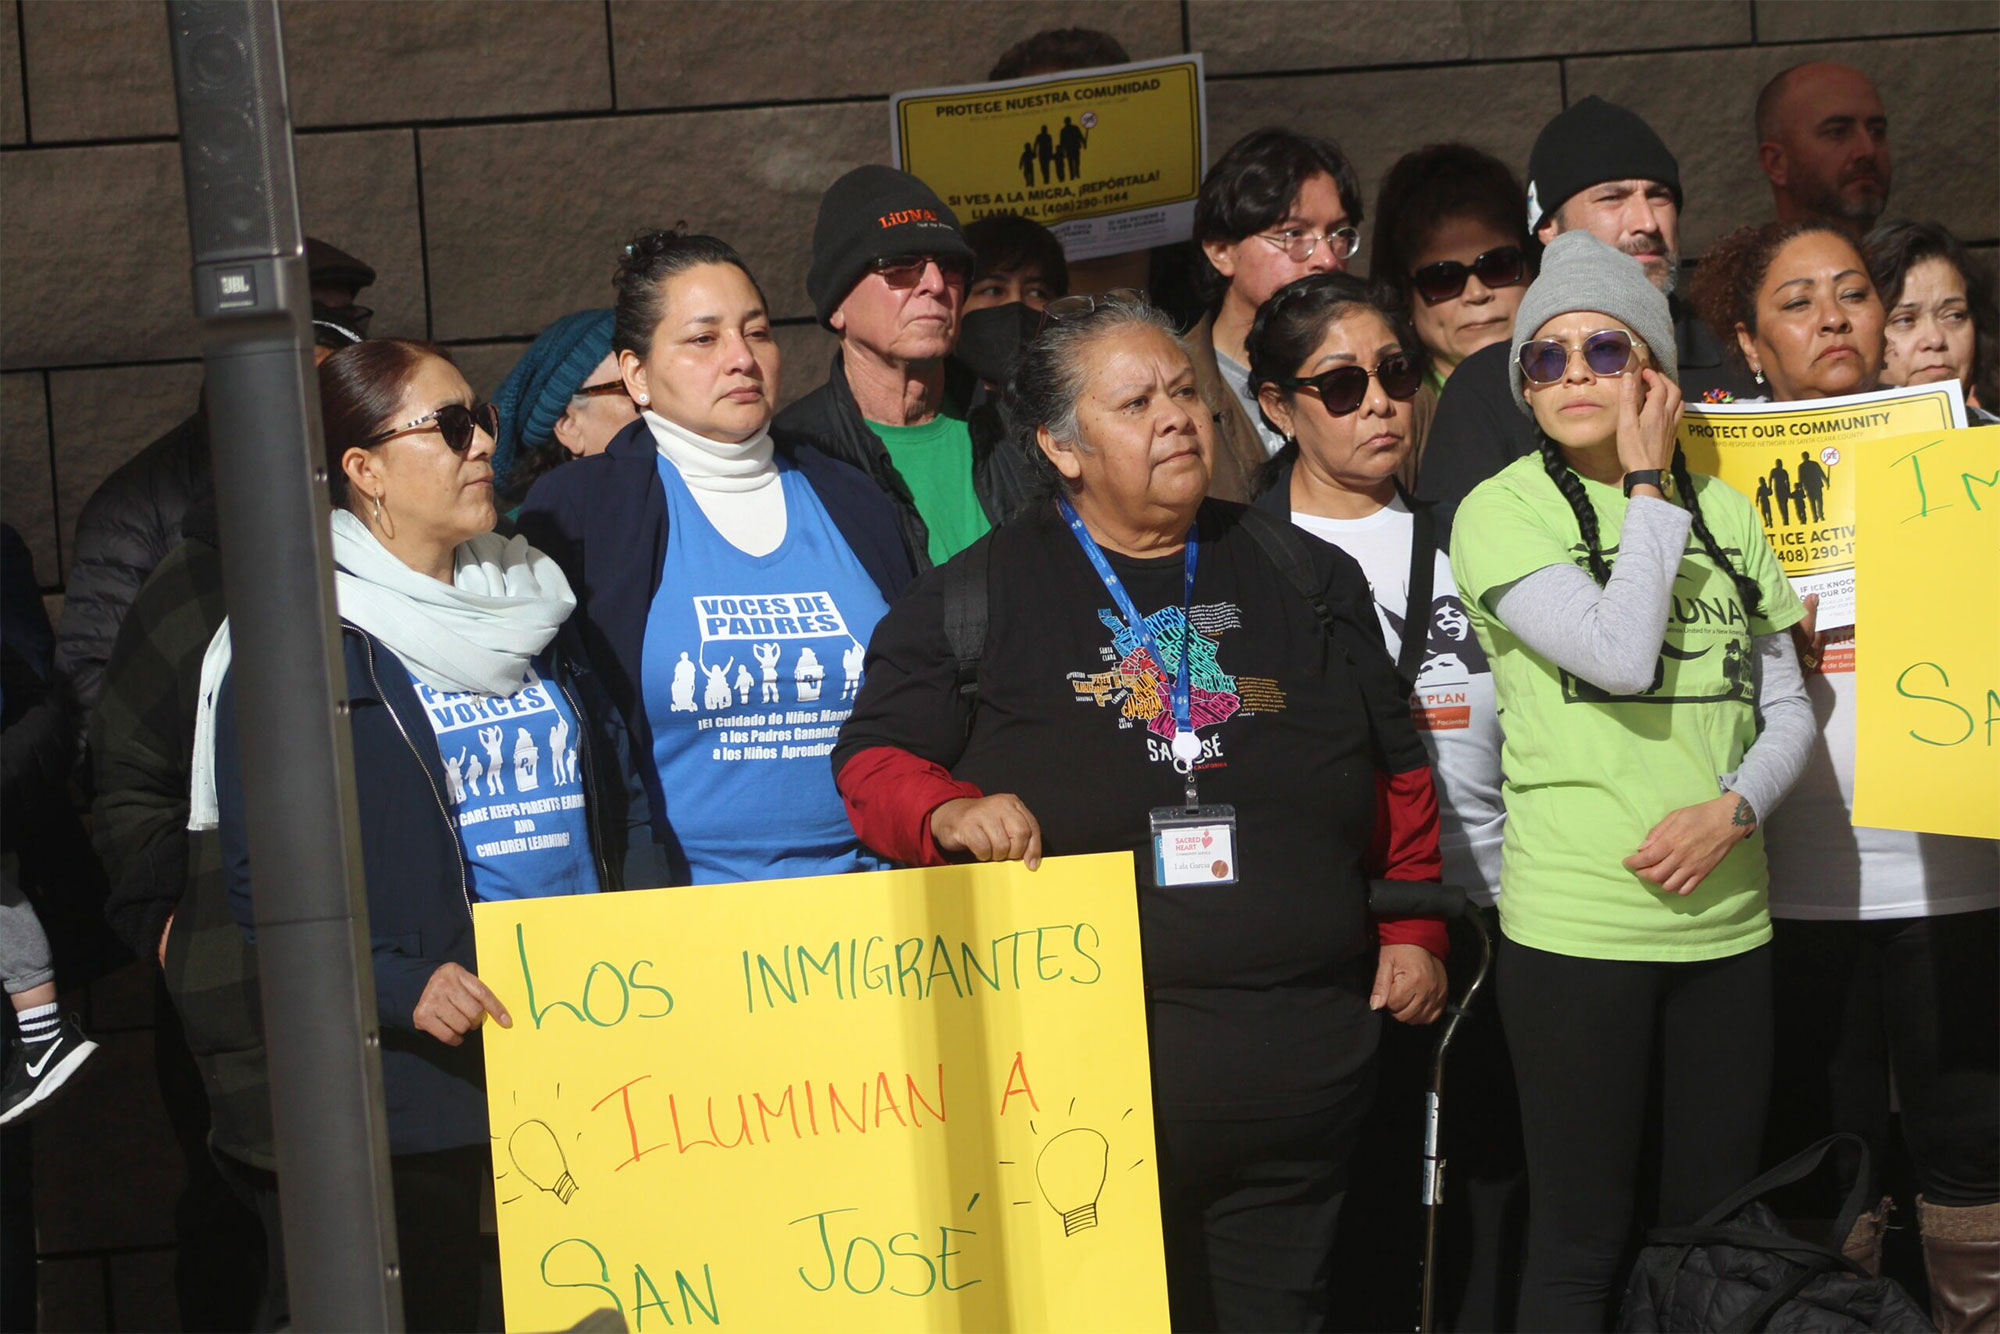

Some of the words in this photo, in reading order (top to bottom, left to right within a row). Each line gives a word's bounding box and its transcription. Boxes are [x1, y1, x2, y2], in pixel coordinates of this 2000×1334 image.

[936, 101, 1002, 117] PROTEGE
[1006, 91, 1070, 110] NUESTRA
[1074, 79, 1161, 100] COMUNIDAD
[948, 196, 960, 206] SI
[964, 193, 992, 205] VES
[996, 193, 1008, 203] A
[1007, 191, 1024, 202] LA
[1028, 186, 1076, 200] MIGRA,
[1022, 205, 1039, 217] AL
[221, 275, 250, 294] JBL
[1687, 423, 1748, 439] PROTECT
[1751, 420, 1785, 437] OUR
[1790, 412, 1891, 436] COMMUNITY
[1757, 440, 1787, 448] NETWORK
[1796, 437, 1816, 445] SANTA
[1816, 435, 1837, 444] CLARA
[1837, 431, 1864, 441] COUNTY
[1781, 531, 1805, 546] ICE
[1810, 525, 1855, 543] ACTIV
[1810, 584, 1824, 593] ICE
[700, 597, 792, 616] VOCES
[793, 595, 830, 613] DE
[706, 613, 841, 636] PADRES
[1427, 693, 1466, 705] PLAN
[715, 713, 766, 728] Cuidado
[768, 712, 783, 725] de
[786, 709, 818, 725] Niños
[720, 733, 728, 742] a
[730, 729, 748, 742] los
[751, 727, 792, 742] Padres
[713, 751, 720, 760] a
[722, 746, 741, 760] los
[744, 745, 777, 760] Niños
[1146, 738, 1173, 762] SA
[459, 806, 489, 827] CARE
[490, 802, 520, 820] KEEPS
[520, 797, 561, 816] PARENTS
[514, 819, 536, 834] AND
[476, 838, 528, 857] CHILDREN
[528, 832, 570, 850] LEARNING!
[1175, 836, 1201, 844] SACRED
[741, 922, 1102, 1014] INMIGRANTES
[591, 1062, 946, 1172] ILUMINAN
[1000, 1050, 1039, 1116] A
[540, 1238, 719, 1332] SAN
[788, 1191, 983, 1297] JOSÉ
